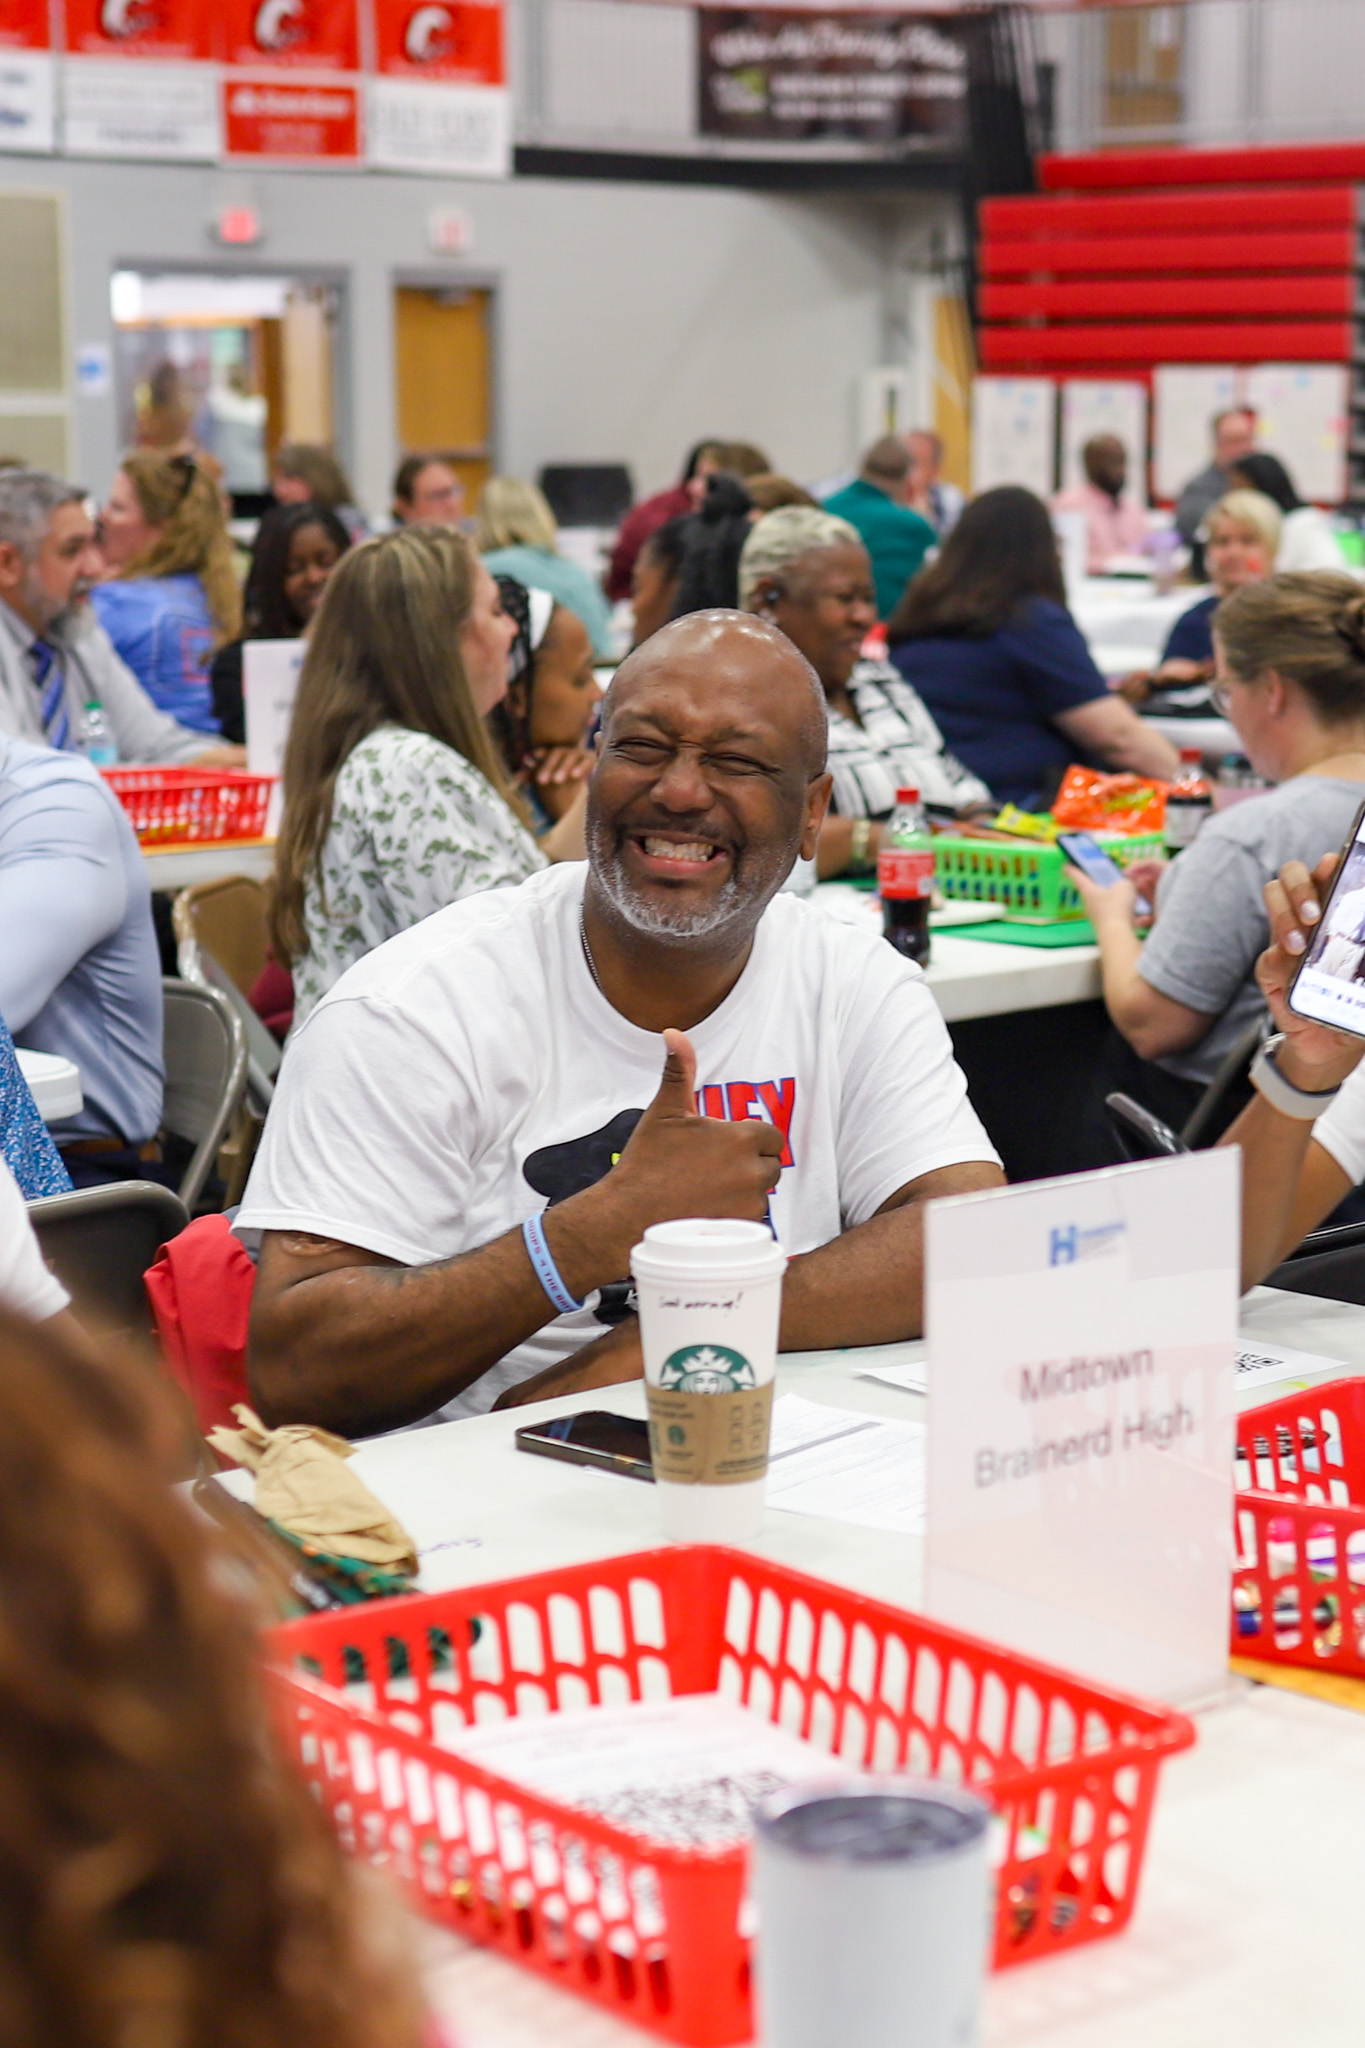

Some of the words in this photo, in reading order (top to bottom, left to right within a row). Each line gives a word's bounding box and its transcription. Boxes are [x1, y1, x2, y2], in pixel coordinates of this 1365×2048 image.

[1020, 1348, 1154, 1404] Midtown
[974, 1416, 1113, 1489] Brainerd
[1122, 1398, 1195, 1451] High
